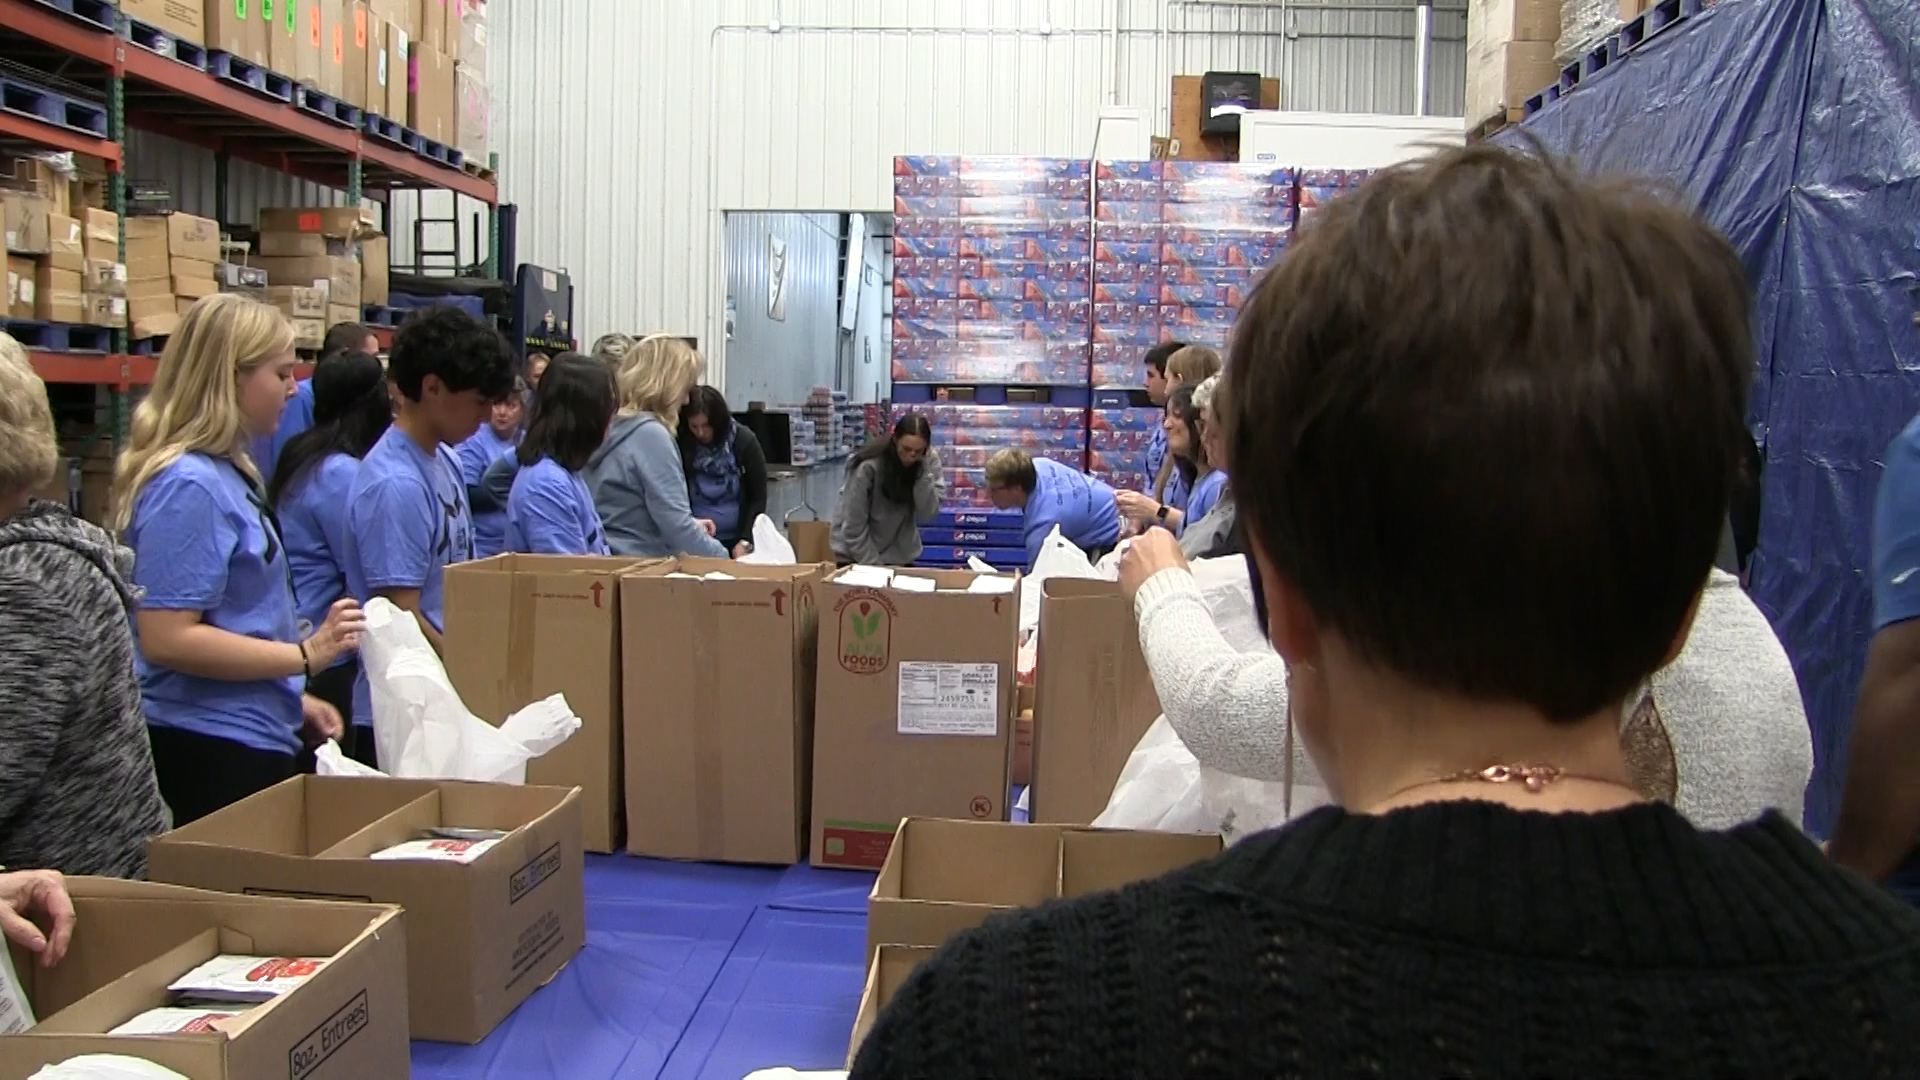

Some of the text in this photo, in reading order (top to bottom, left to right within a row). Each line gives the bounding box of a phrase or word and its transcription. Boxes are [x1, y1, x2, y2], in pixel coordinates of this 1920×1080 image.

[843, 655, 885, 666] FOODS
[530, 851, 560, 883] Entrees
[293, 1003, 365, 1076] 8oz. Entrees
